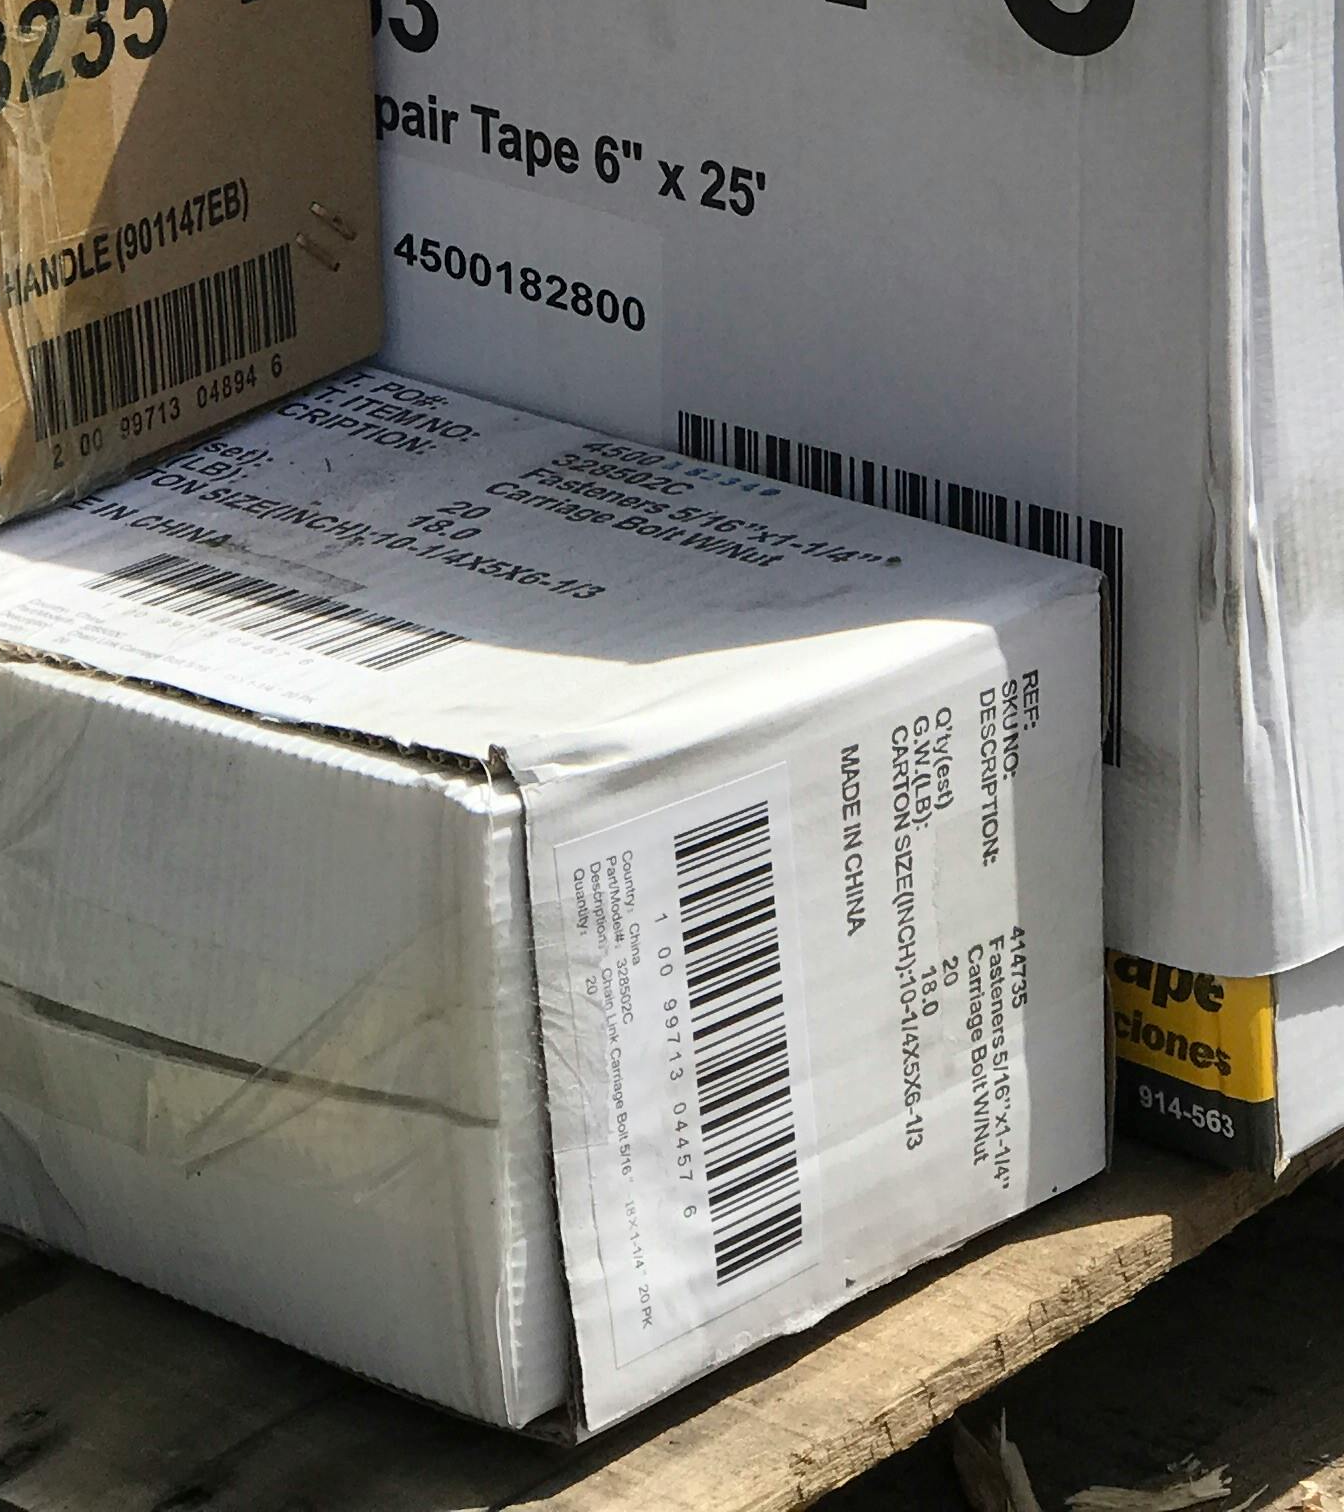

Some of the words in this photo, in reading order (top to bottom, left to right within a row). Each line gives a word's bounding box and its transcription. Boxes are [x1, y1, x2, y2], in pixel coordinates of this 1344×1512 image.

[375, 93, 459, 145] pair
[470, 103, 580, 176] Tape
[594, 134, 643, 185] 6"
[657, 159, 687, 202] x
[699, 159, 767, 217] 25'
[5, 234, 113, 307] HANDLE
[114, 176, 249, 274] (901147EB)
[393, 232, 646, 332] 4500182800
[80, 427, 104, 457] 00
[120, 396, 181, 439] 99713
[196, 364, 258, 409] 04894
[271, 352, 284, 379] 6
[339, 395, 430, 430] ITEM
[519, 466, 672, 515] Fasteners
[551, 452, 696, 497] 328502C
[89, 501, 140, 522] IN
[129, 514, 234, 548] CHINA
[407, 514, 483, 541] 18.0
[436, 500, 492, 520] 20
[485, 480, 615, 525] Carriage
[611, 515, 687, 543] Bolt
[677, 530, 785, 568] W/Nut
[1022, 669, 1039, 731] REF:
[840, 743, 861, 821] MADE
[891, 725, 911, 833] CARTON
[910, 715, 933, 832] G.W.(LB):
[932, 706, 954, 810] Q'ty(est)
[979, 687, 1000, 868] DESCRIPTION:
[843, 822, 864, 852] IN
[844, 853, 867, 937] CHINA
[628, 922, 642, 966] China
[942, 954, 959, 987] 20
[1009, 925, 1028, 1010] 414735
[584, 975, 599, 997] 20
[601, 967, 614, 1012] Chain
[616, 957, 635, 1025] 328502C
[921, 965, 939, 1017] 18.0
[966, 943, 984, 1043] Carriage
[989, 935, 1005, 1050] Fasteners
[605, 1013, 618, 1045] Link
[1113, 1008, 1232, 1077] ciones
[609, 1046, 626, 1110] Carriage
[654, 912, 668, 924] 1
[682, 1204, 698, 1219] 6
[971, 1044, 989, 1093] Bolt
[616, 1112, 631, 1141] Bolt
[972, 1093, 990, 1167] W/Nut
[1138, 1084, 1235, 1139] 914-563
[638, 1283, 651, 1306] 20
[641, 1306, 654, 1330] PK
